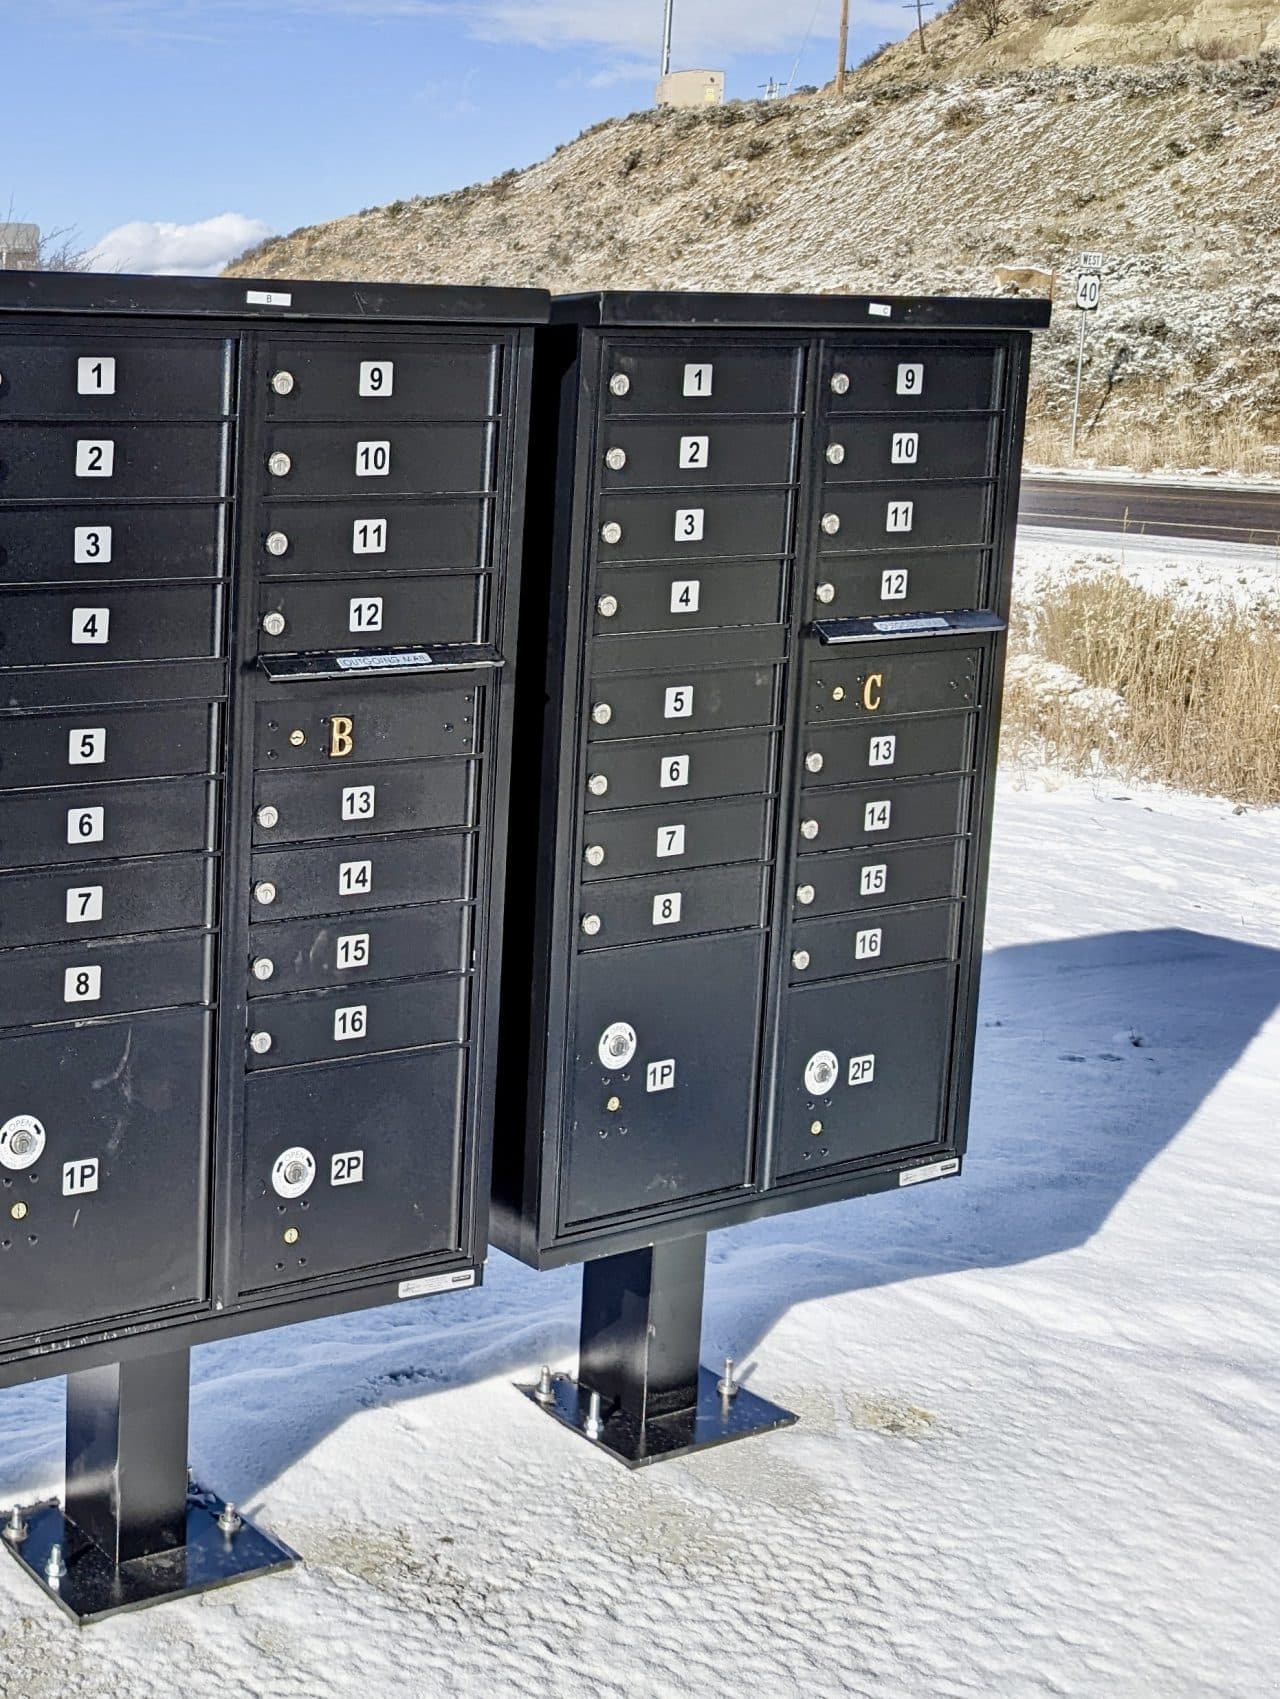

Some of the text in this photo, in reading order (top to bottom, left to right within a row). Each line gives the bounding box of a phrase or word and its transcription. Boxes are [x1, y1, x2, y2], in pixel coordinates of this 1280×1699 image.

[1083, 255, 1101, 266] WEST
[1080, 282, 1097, 302] 40
[91, 362, 102, 389] 1
[370, 367, 383, 391] 9
[694, 368, 703, 391] 1
[904, 368, 916, 390] 9
[87, 446, 103, 471] 2
[360, 446, 386, 470] 10
[688, 441, 700, 463] 2
[895, 437, 915, 458] 10
[683, 514, 695, 536] 3
[891, 506, 909, 527] 11
[85, 532, 100, 558] 3
[358, 524, 382, 548] 11
[678, 585, 691, 607] 4
[885, 574, 905, 595] 12
[82, 613, 98, 638] 4
[353, 603, 379, 627] 12
[342, 657, 400, 667] OUTGOING
[673, 691, 684, 712] 5
[863, 674, 882, 710] C
[80, 734, 95, 758] 5
[330, 717, 353, 757] B
[873, 740, 892, 761] 13
[669, 760, 680, 782] 6
[346, 791, 371, 815] 13
[78, 813, 93, 837] 6
[868, 805, 887, 826] 14
[666, 830, 677, 851] 7
[342, 865, 369, 890] 14
[864, 869, 883, 890] 15
[77, 892, 92, 916] 7
[661, 898, 672, 919] 8
[340, 939, 366, 963] 15
[859, 933, 878, 954] 16
[75, 972, 90, 996] 8
[338, 1010, 363, 1034] 16
[649, 1064, 673, 1087] 1P
[851, 1060, 872, 1081] 2P
[8, 1118, 32, 1132] OPEN
[65, 1164, 96, 1190] 1P
[333, 1156, 361, 1181] 2P
